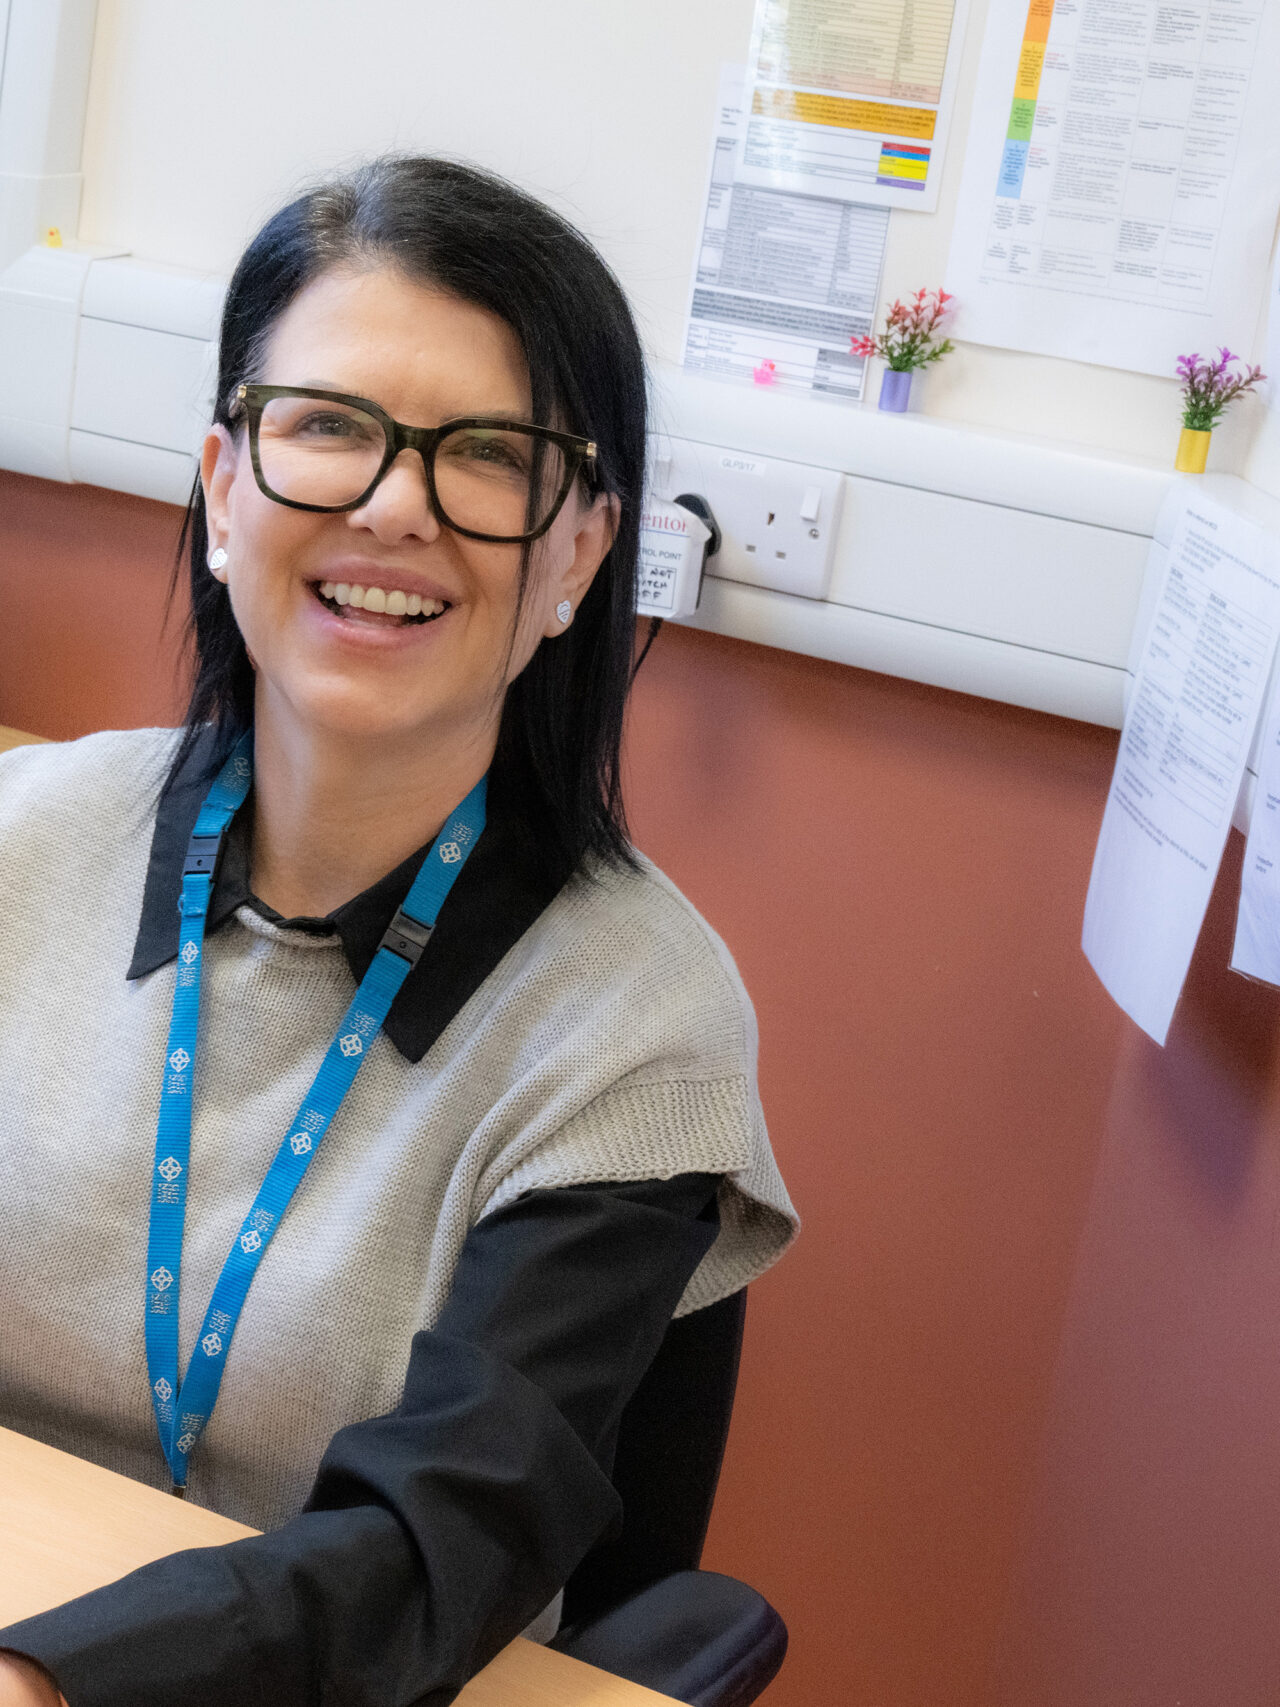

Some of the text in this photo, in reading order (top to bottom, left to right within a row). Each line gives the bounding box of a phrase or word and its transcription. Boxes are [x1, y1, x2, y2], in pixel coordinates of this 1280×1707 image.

[659, 550, 682, 560] POINT
[650, 568, 674, 580] NOT
[348, 1008, 364, 1029] GIG
[358, 1014, 374, 1035] NHS
[298, 1106, 314, 1128] GIG
[308, 1112, 323, 1133] NHS
[207, 1307, 221, 1329] GIG
[215, 1311, 229, 1333] NHS
